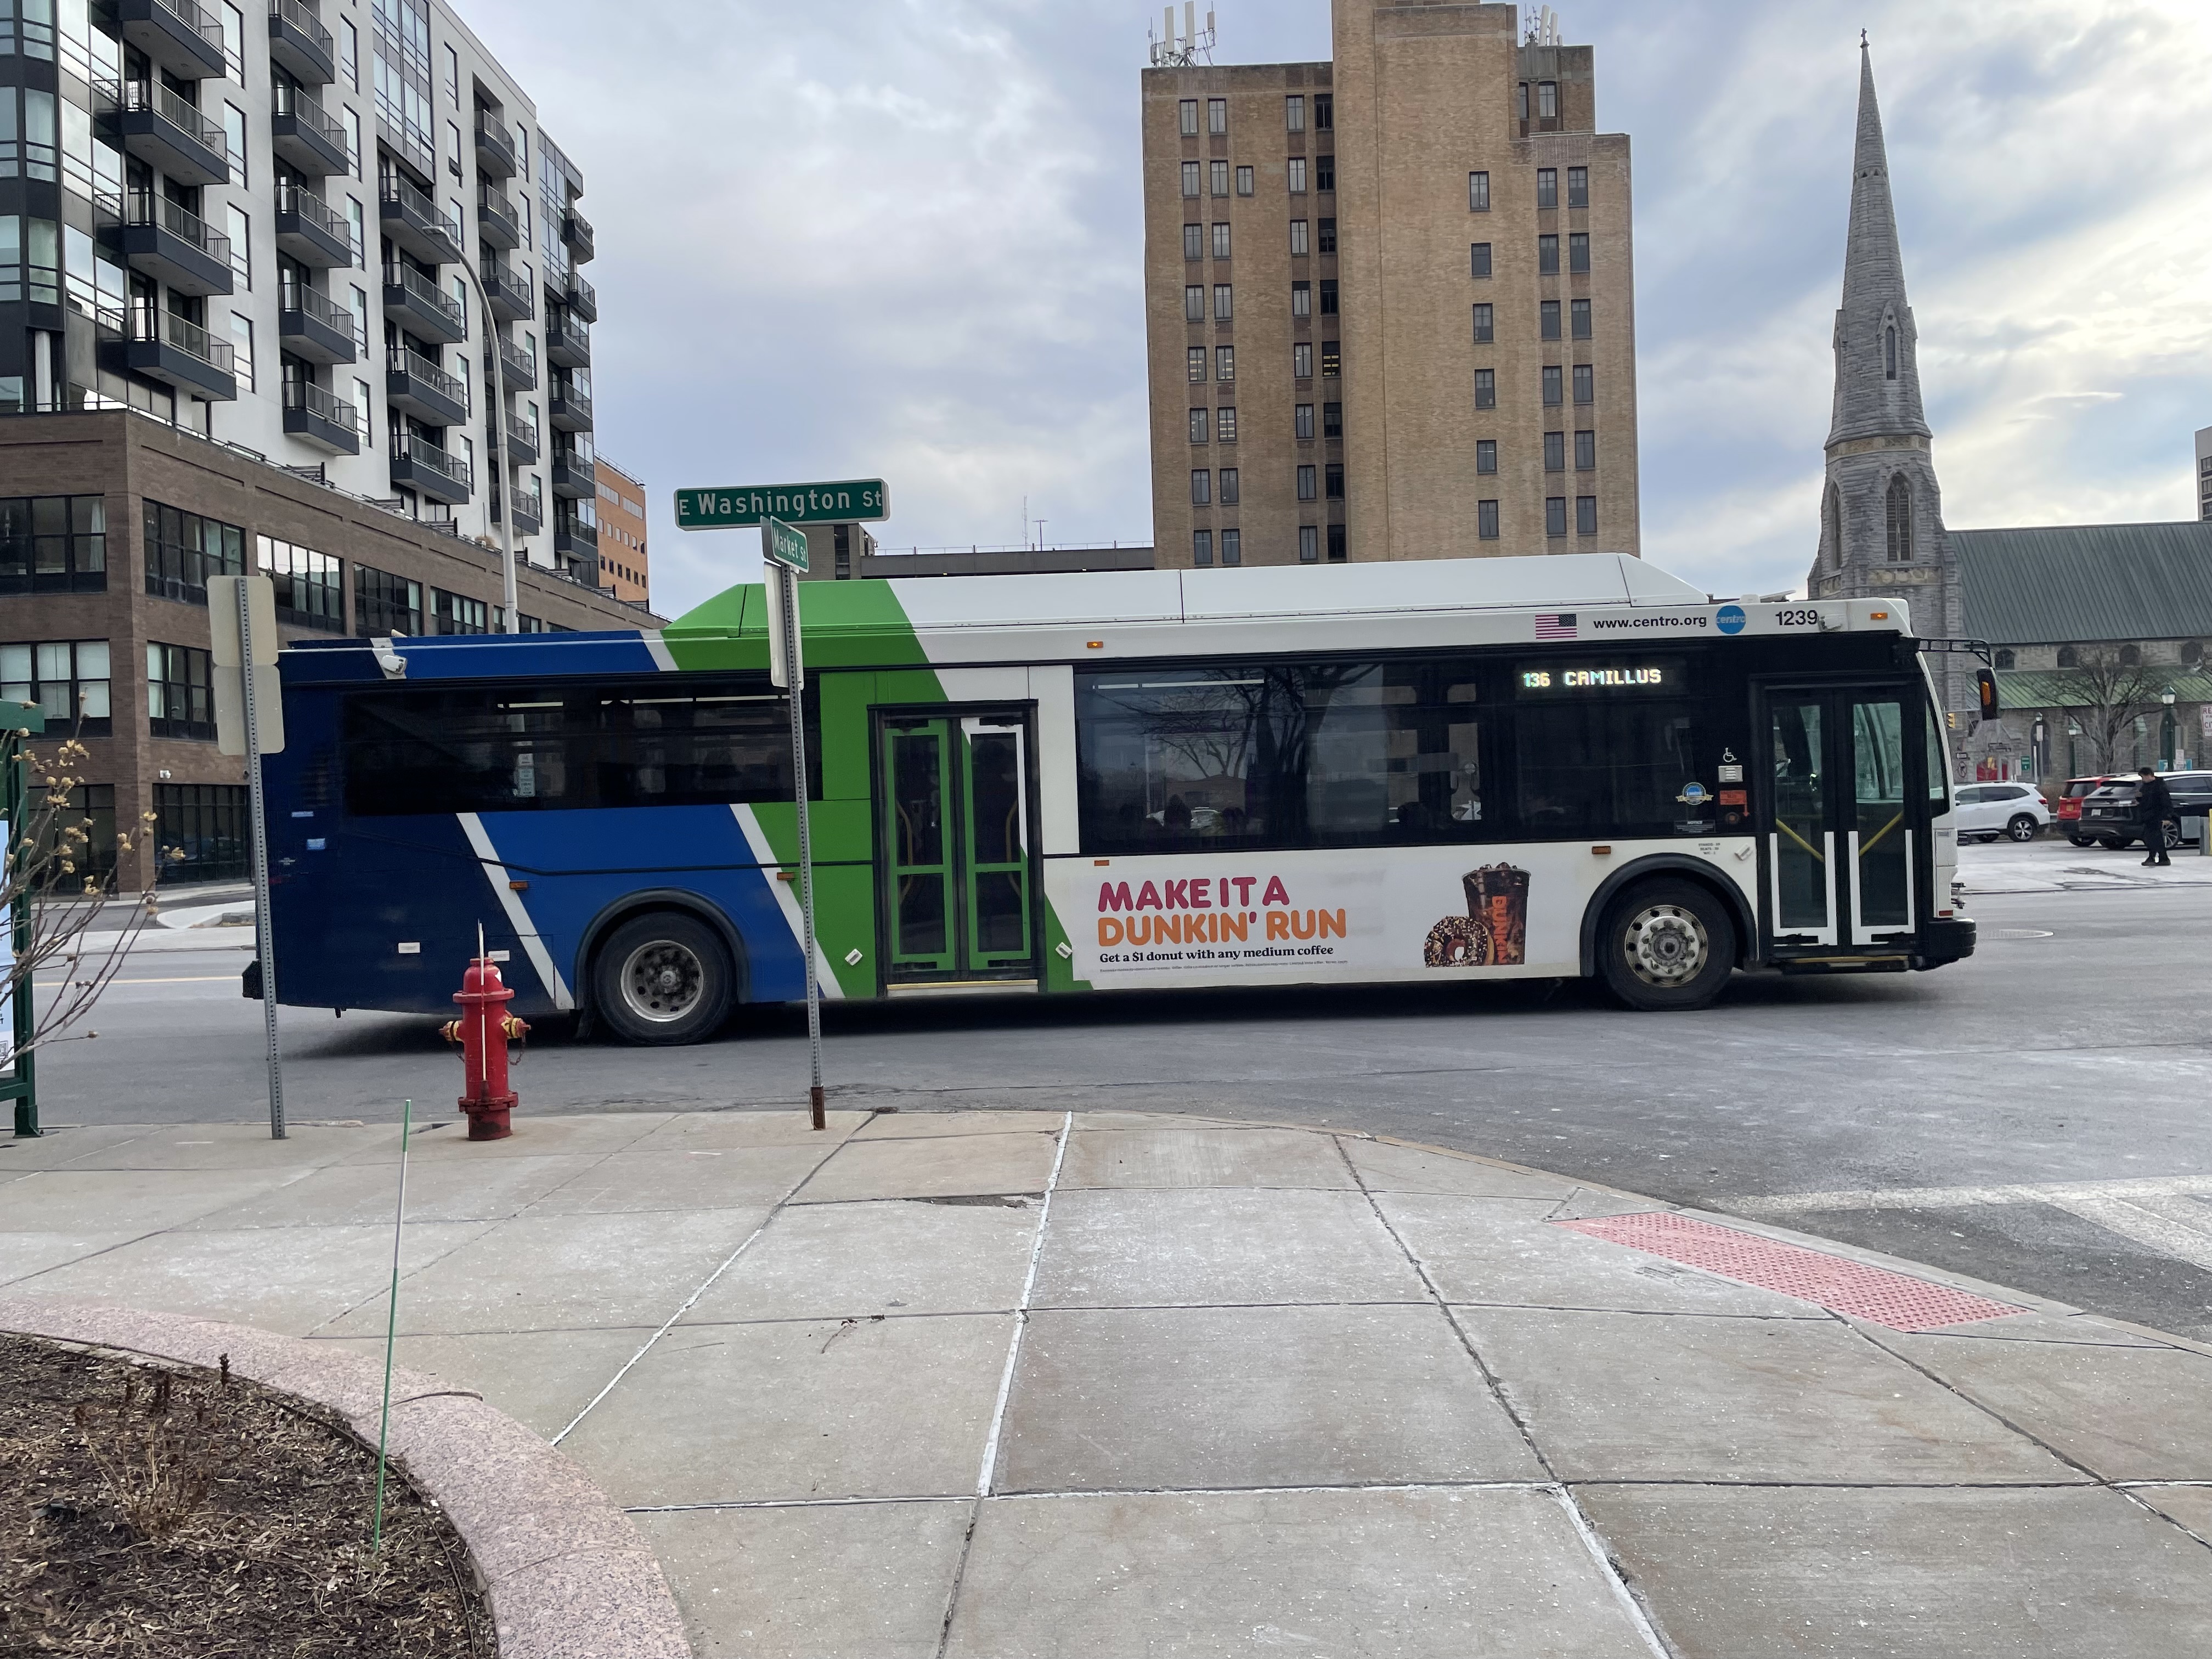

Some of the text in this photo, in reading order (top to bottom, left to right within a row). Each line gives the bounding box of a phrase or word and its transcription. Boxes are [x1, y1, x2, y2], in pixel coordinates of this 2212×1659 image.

[679, 489, 882, 517] E Washington St
[773, 527, 799, 559] Market
[1593, 616, 1707, 629] www.centro.org
[1716, 614, 1746, 624] centro
[1775, 610, 1818, 626] 1239
[1522, 668, 1662, 688] 136 CAMILLUS
[1098, 876, 1289, 912] MAKE IT A
[1098, 909, 1347, 946] DUNKIN' RUN
[1099, 953, 1120, 963] Get
[1132, 951, 1144, 962] $1
[1147, 951, 1184, 961] donut
[1186, 949, 1215, 960] with
[1218, 951, 1240, 960] any
[1243, 947, 1295, 957] medium
[1297, 945, 1334, 956] coffee
